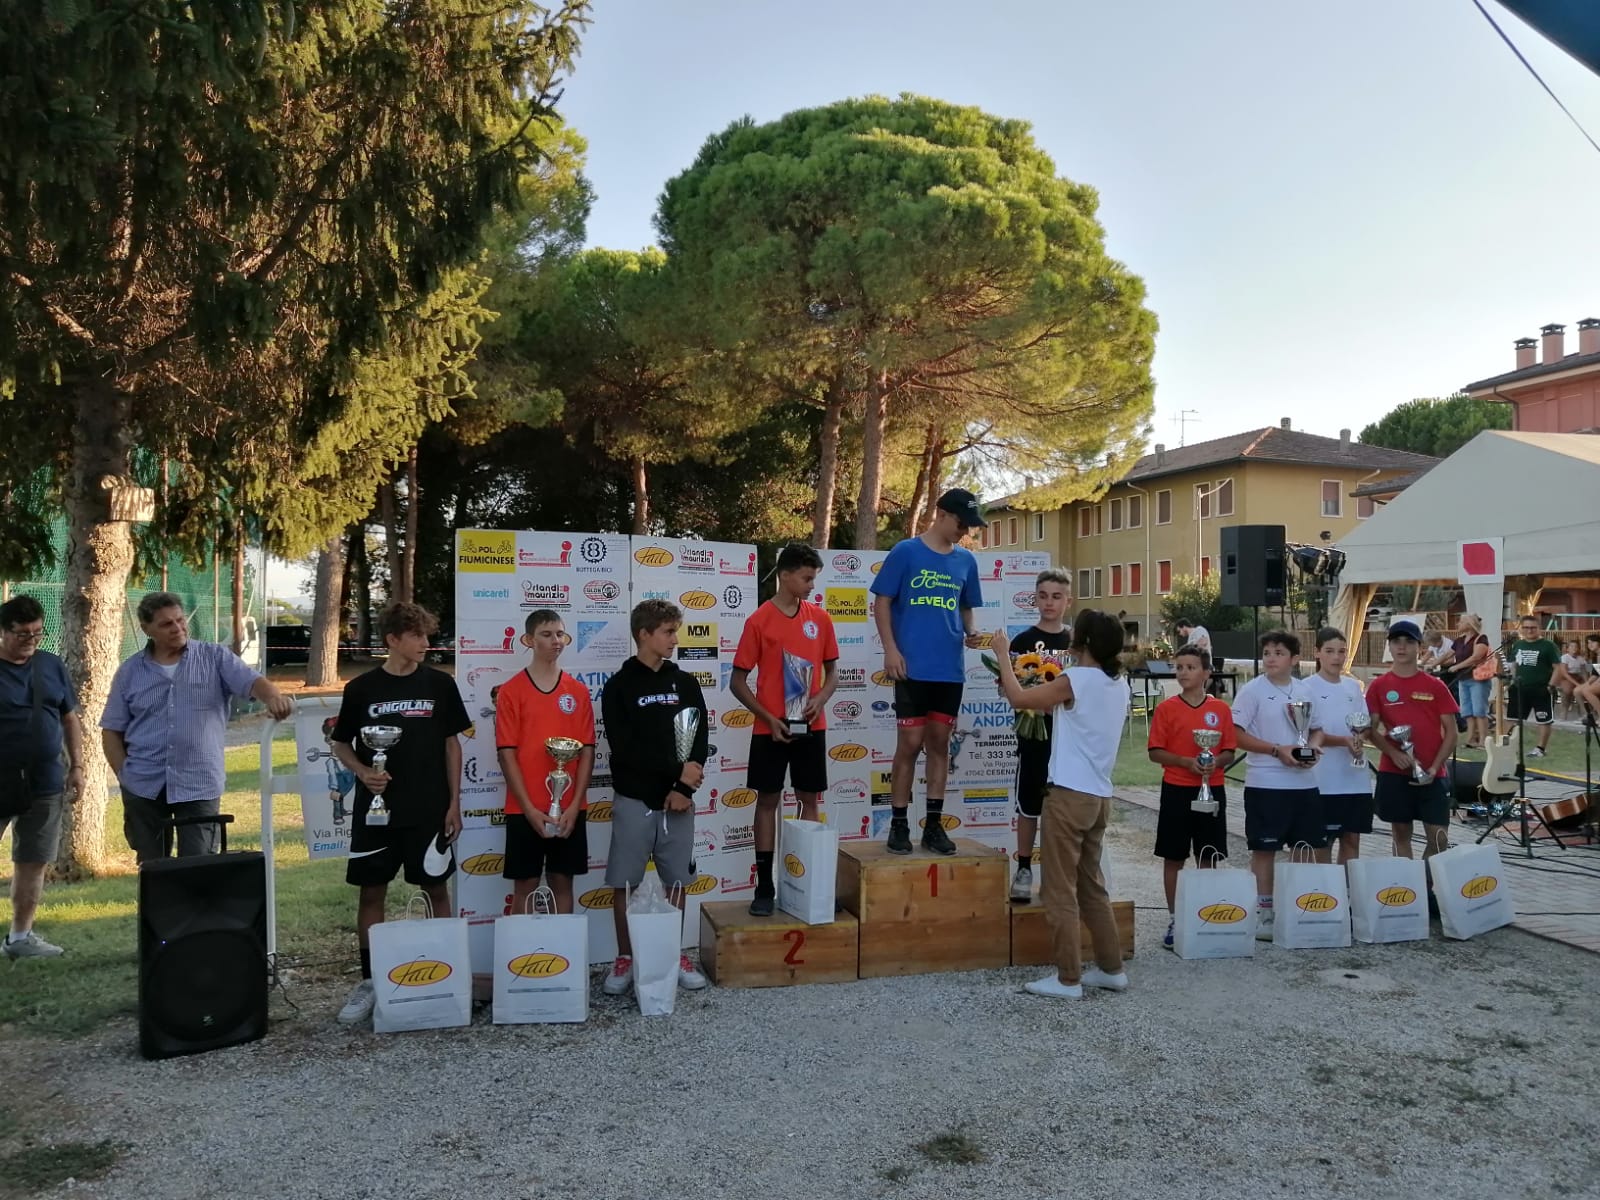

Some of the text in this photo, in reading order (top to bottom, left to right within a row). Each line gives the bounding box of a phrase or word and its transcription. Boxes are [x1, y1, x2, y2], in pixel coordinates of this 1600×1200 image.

[459, 556, 515, 565] FIUMICINESE
[521, 580, 559, 592] Orlandi
[527, 591, 566, 599] maurizio
[910, 596, 957, 611] LEVELO
[973, 715, 1015, 727] ANDR
[968, 750, 1017, 760] Tel. 333 94
[995, 760, 1018, 769] Rigoss
[986, 768, 1016, 776] CESENA
[313, 827, 353, 839] Via Rig
[313, 841, 347, 852] Email:
[926, 863, 938, 898] 1
[783, 930, 805, 965] 2
